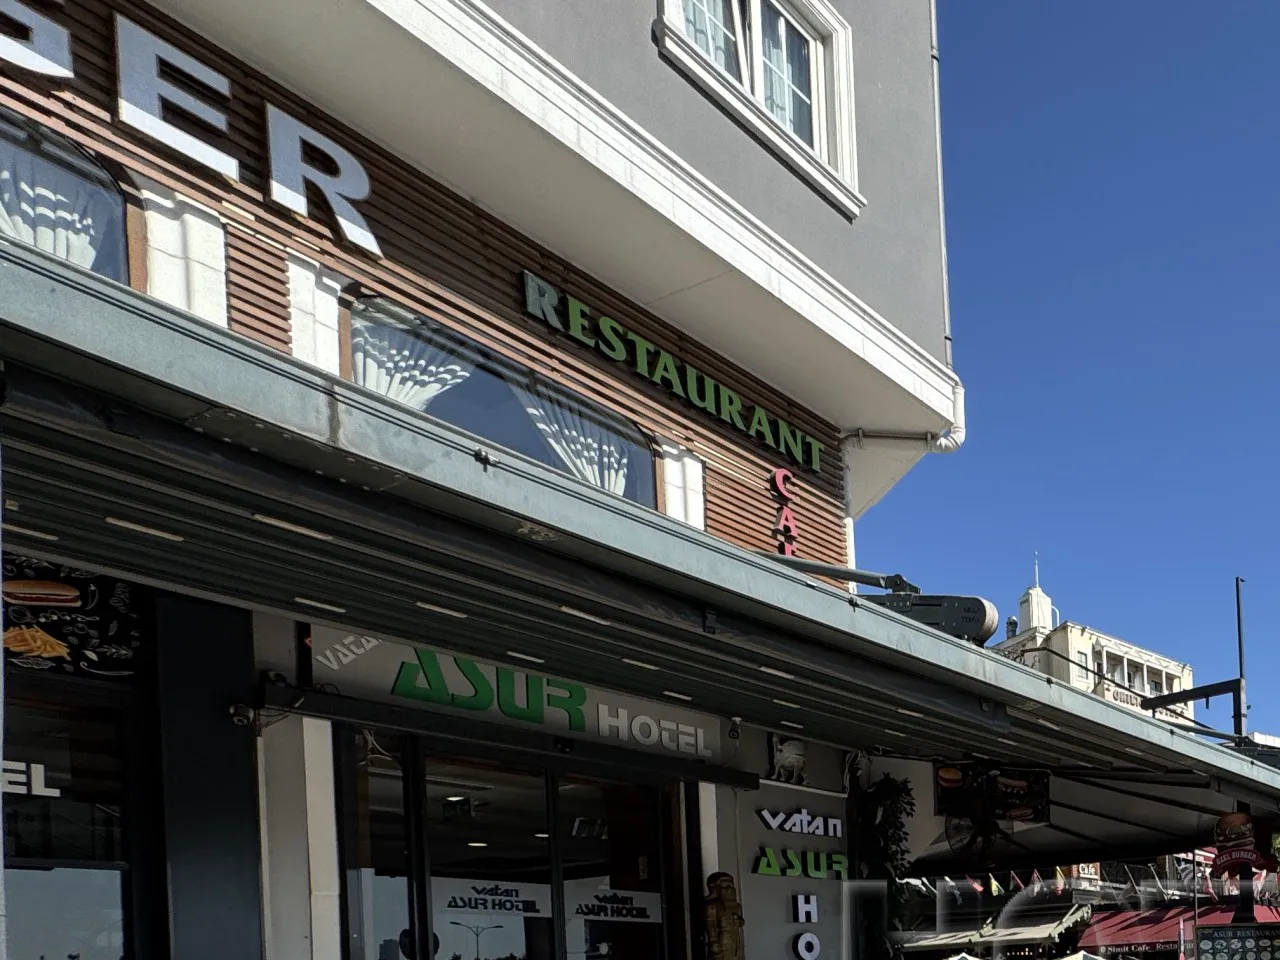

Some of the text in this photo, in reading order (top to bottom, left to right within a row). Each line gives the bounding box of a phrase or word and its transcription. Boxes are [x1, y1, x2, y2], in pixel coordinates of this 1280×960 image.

[524, 270, 824, 472] RESTAURANT
[391, 647, 586, 732] ASUR
[599, 704, 712, 757] HOTEL
[755, 847, 848, 880] ASUR
[447, 896, 540, 913] ASUR HOTEL
[575, 903, 650, 919] ASUR HOTEL
